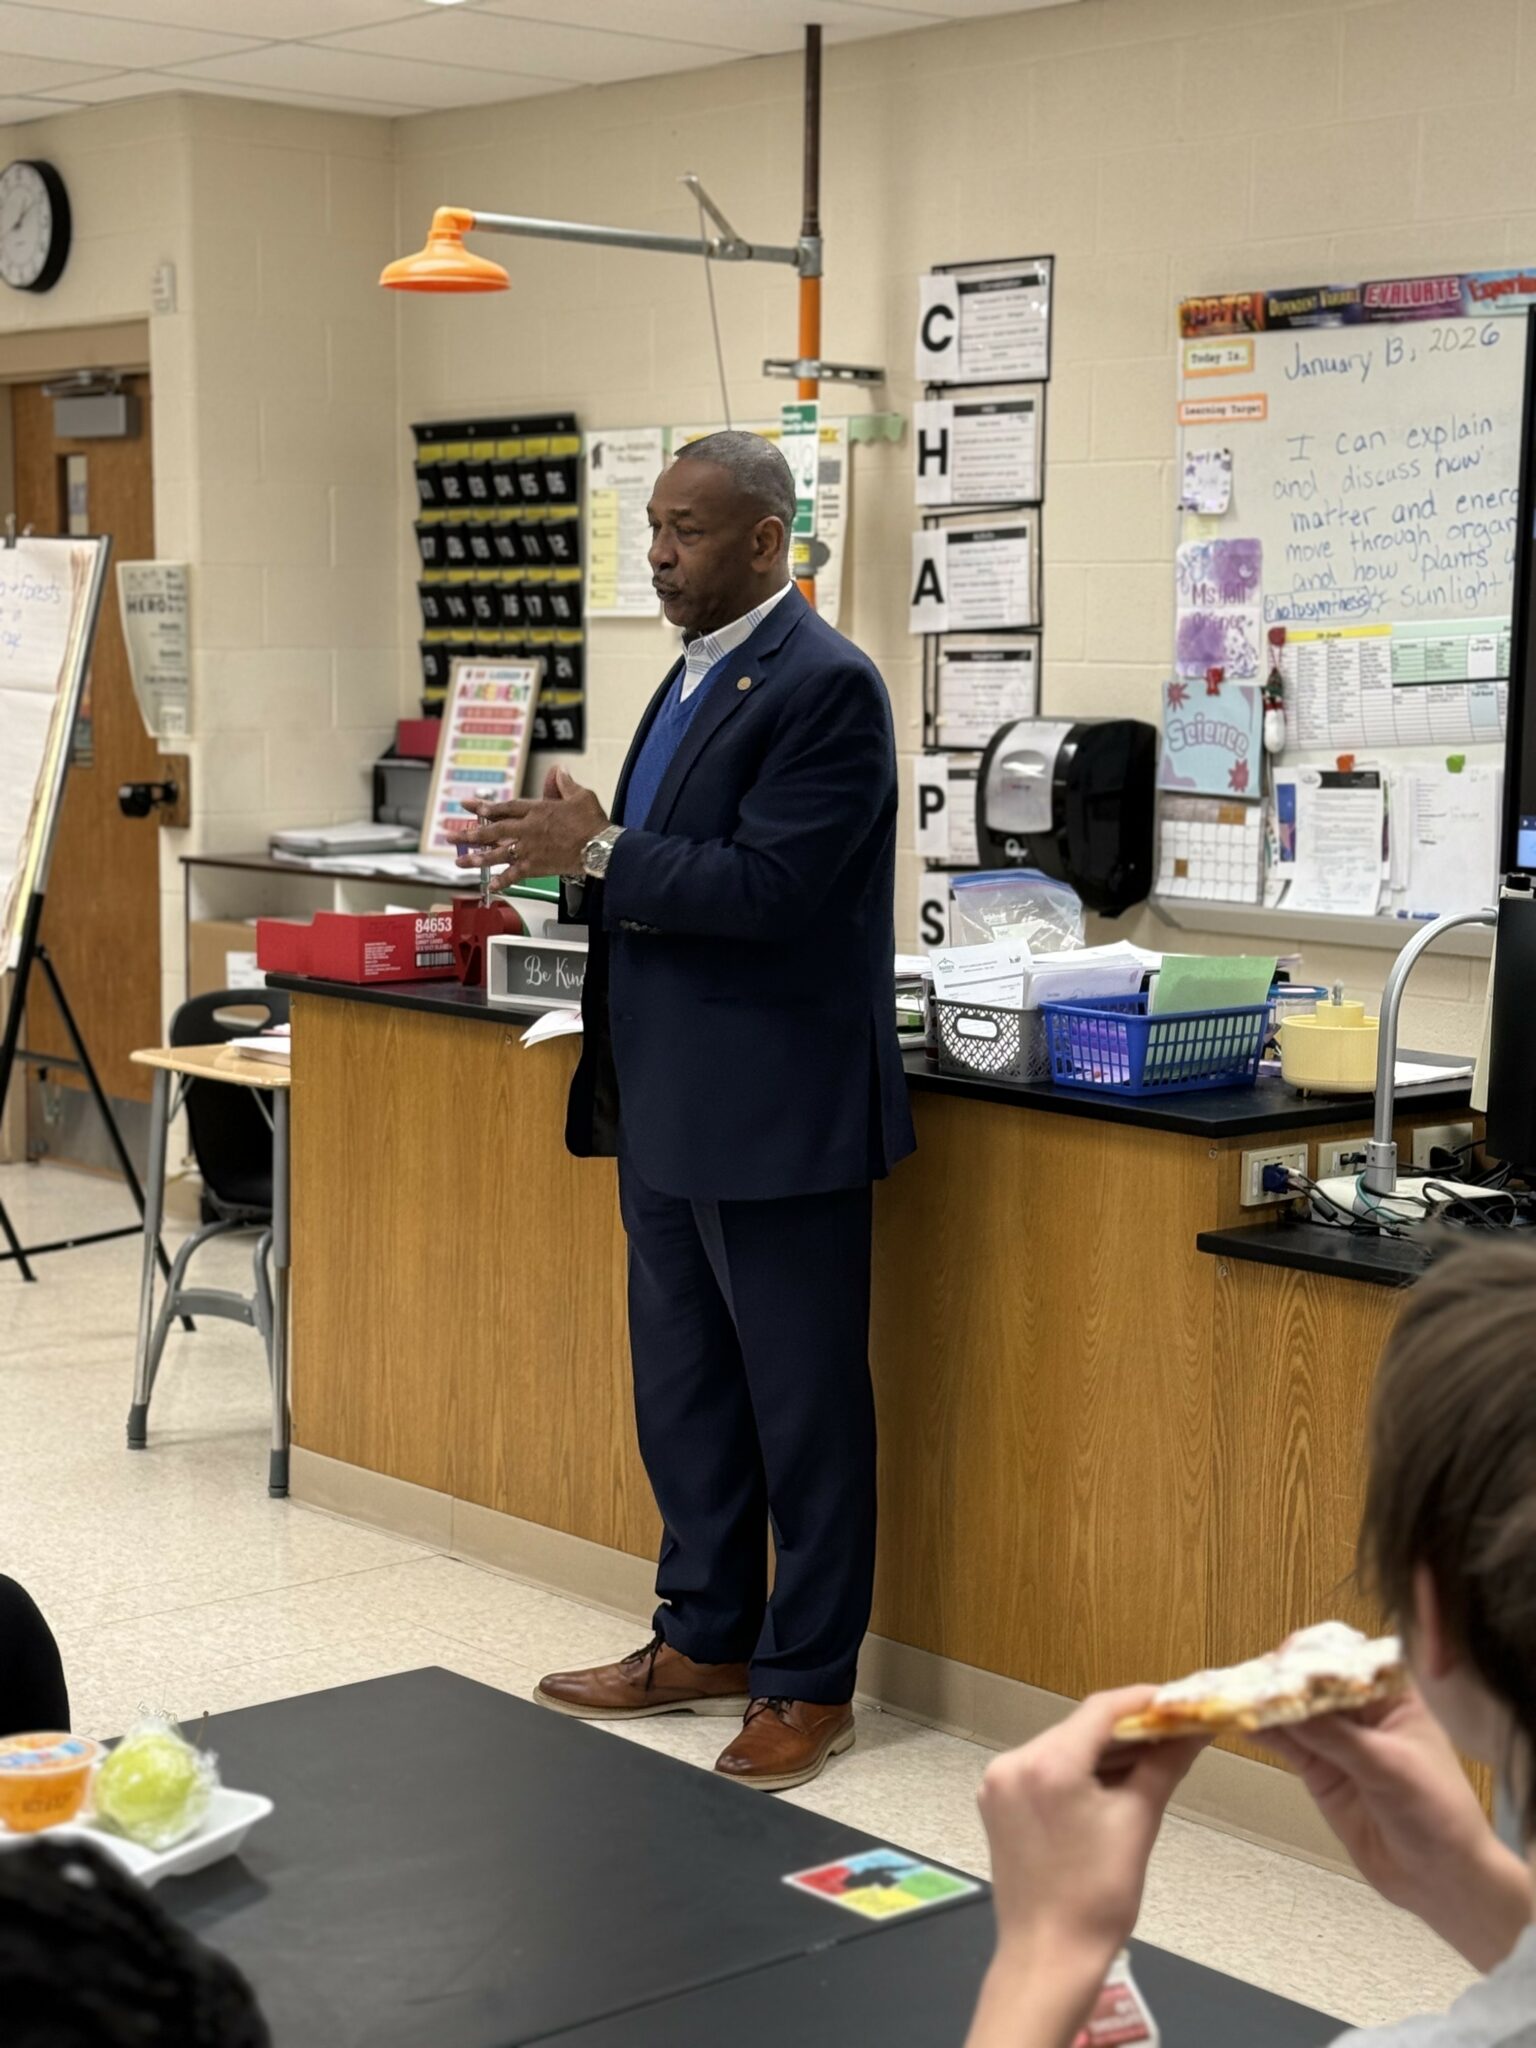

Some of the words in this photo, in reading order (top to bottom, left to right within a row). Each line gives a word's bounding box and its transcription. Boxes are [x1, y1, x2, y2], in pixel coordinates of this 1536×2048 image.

[1364, 277, 1461, 308] EVALUATE
[921, 304, 954, 352] C
[1191, 351, 1221, 365] Today
[1284, 341, 1373, 383] January
[1428, 321, 1501, 353] 2026
[1185, 405, 1226, 416] Learning
[1231, 403, 1262, 414] Target
[917, 427, 949, 477] H
[1286, 433, 1315, 462] I
[1335, 429, 1387, 455] can
[1406, 414, 1493, 452] explain
[1272, 469, 1318, 500] and
[1342, 458, 1421, 494] discuss
[1290, 498, 1377, 534] matter
[1391, 489, 1438, 525] and
[1284, 541, 1335, 563] move
[1350, 525, 1431, 563] through
[911, 557, 946, 606] A
[1291, 567, 1338, 593] and
[1352, 559, 1399, 584] how
[1421, 541, 1489, 582] plants
[1166, 711, 1250, 757] Science
[918, 785, 945, 830] P
[415, 917, 453, 933] 84653
[920, 899, 946, 946] S
[523, 954, 552, 986] Be
